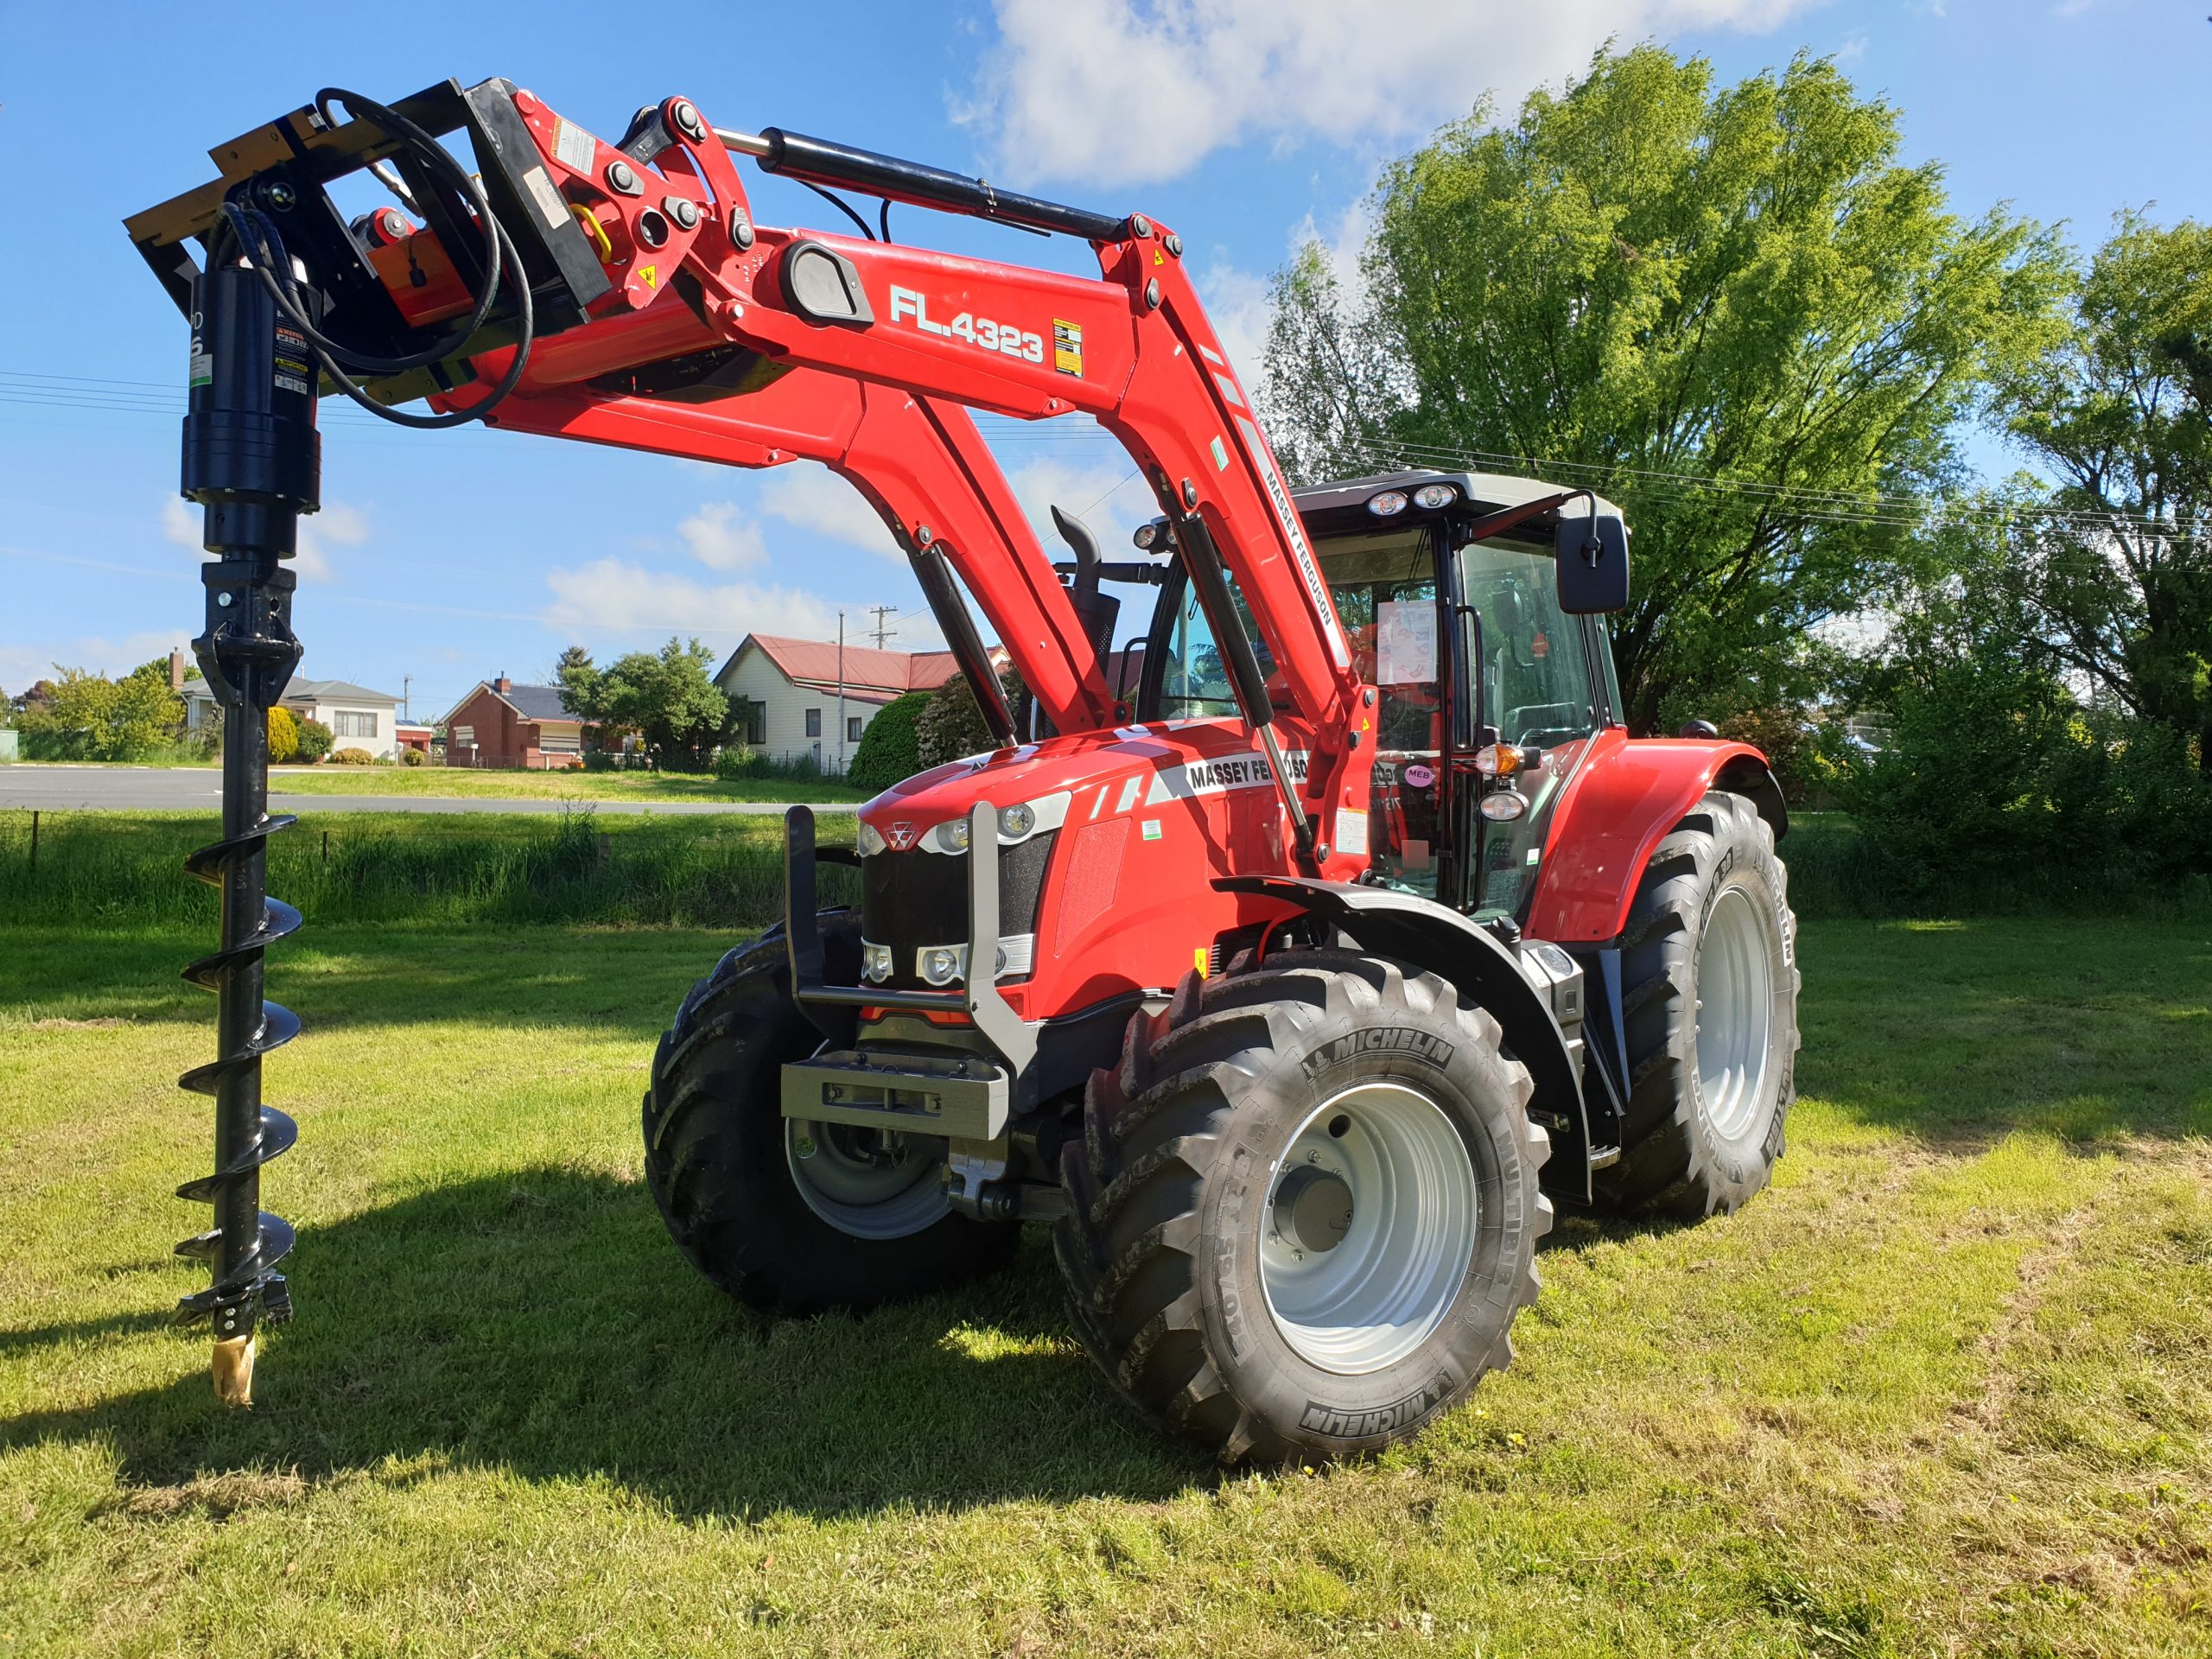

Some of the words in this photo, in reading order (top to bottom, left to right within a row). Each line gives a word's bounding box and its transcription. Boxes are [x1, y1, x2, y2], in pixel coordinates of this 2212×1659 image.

[889, 283, 1044, 364] FL.4323
[1266, 472, 1299, 539] MASSEY
[1296, 541, 1332, 626] FERGUSON
[1190, 761, 1249, 789] MASSEY
[1408, 769, 1430, 779] MEB
[1765, 862, 1793, 960] MICHELIN
[1332, 1028, 1453, 1063] MICHELIN
[1496, 1129, 1522, 1287] MULTIBIB
[1300, 1391, 1426, 1436] MICHELIN
